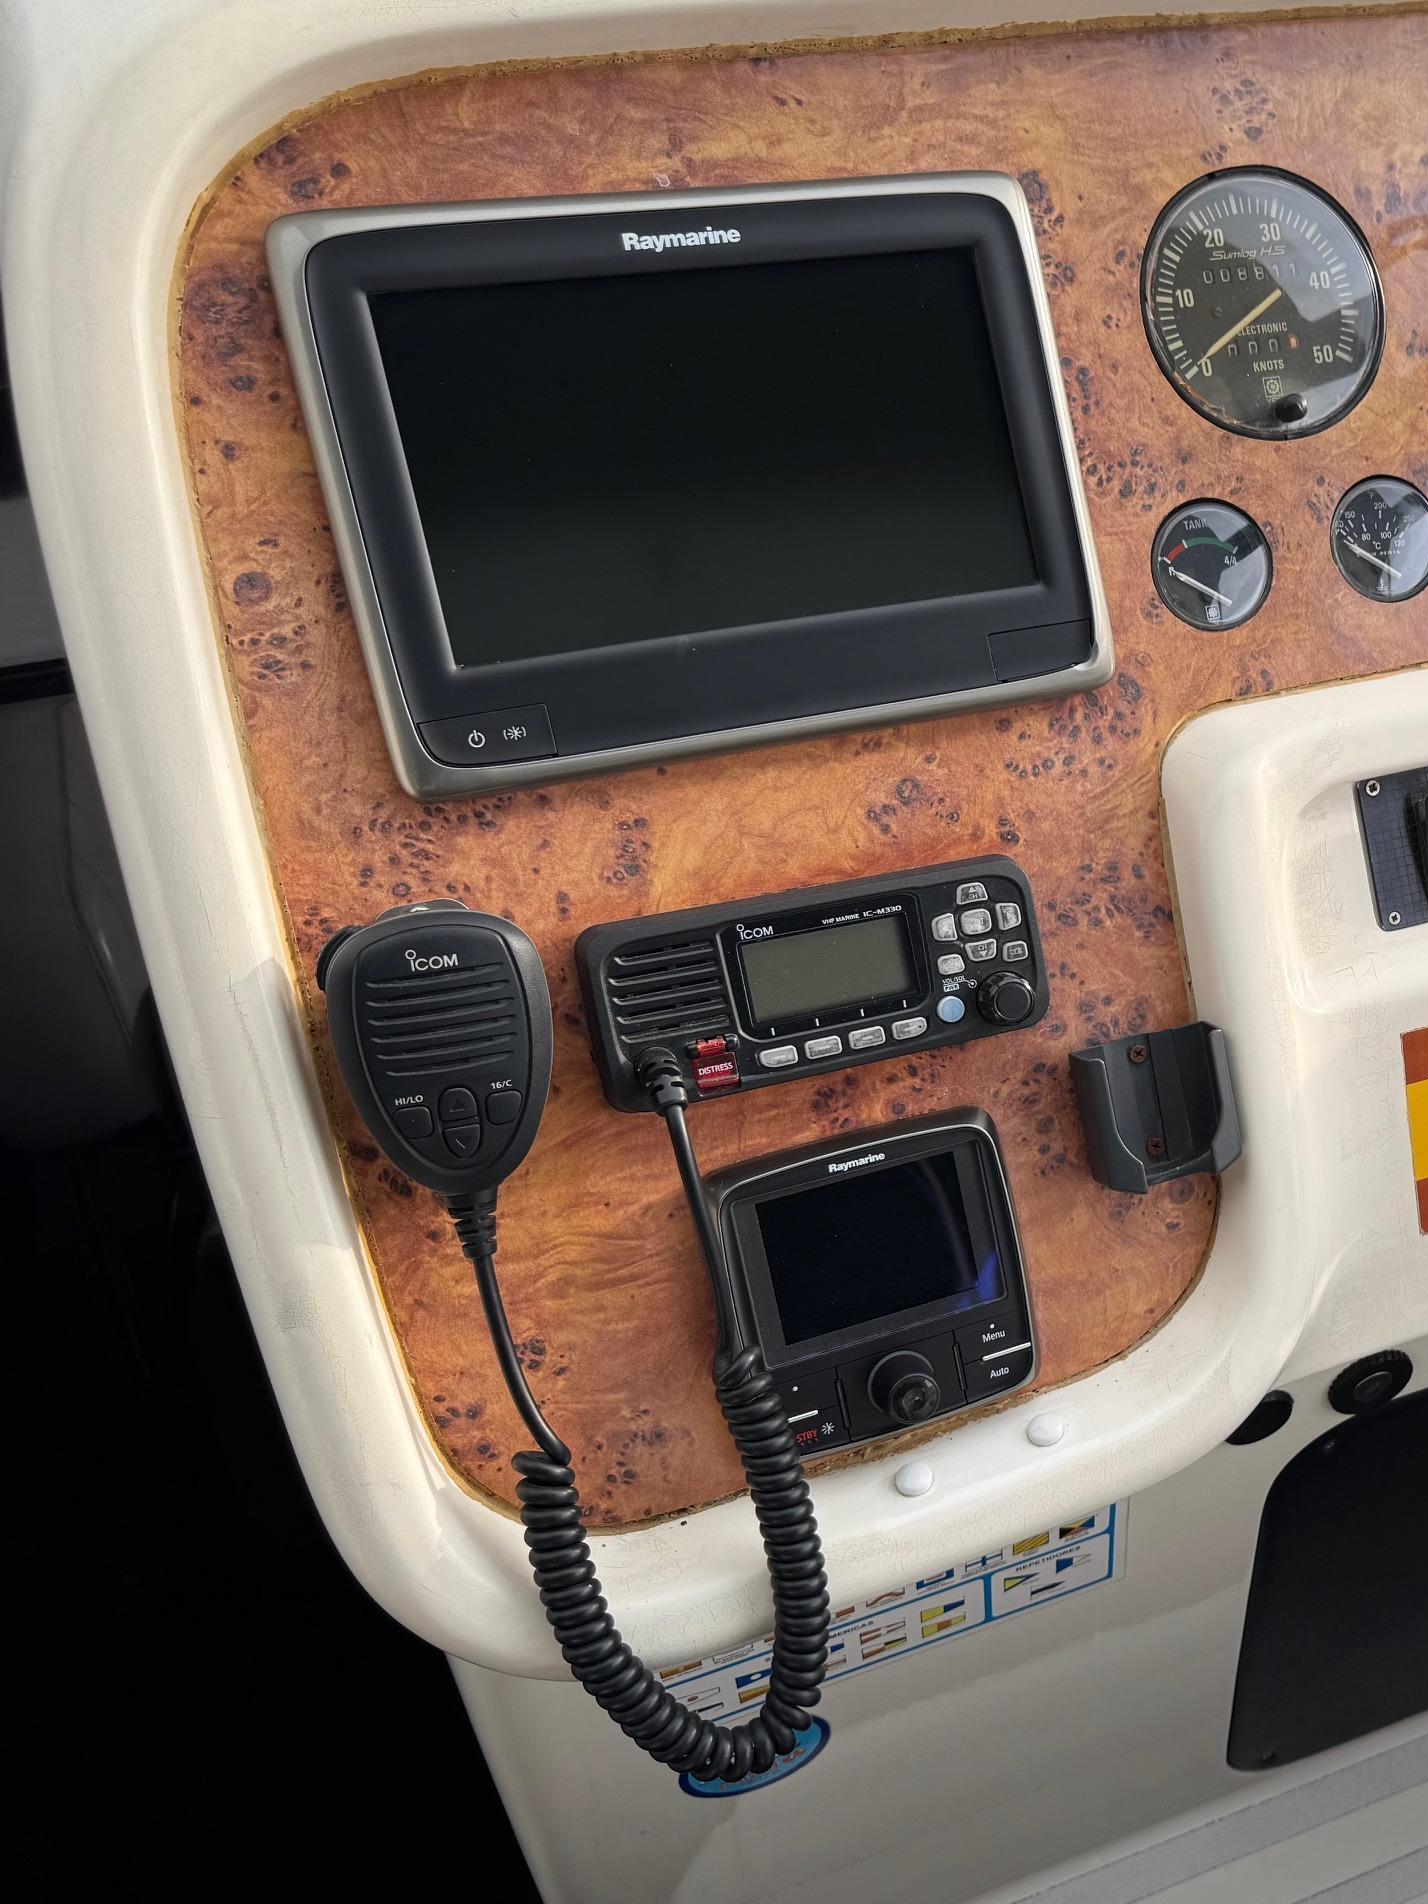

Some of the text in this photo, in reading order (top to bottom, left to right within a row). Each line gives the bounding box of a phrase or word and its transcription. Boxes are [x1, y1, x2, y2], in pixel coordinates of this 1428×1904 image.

[621, 226, 741, 252] Raymarine
[1203, 228, 1224, 248] 20
[1260, 223, 1281, 242] 30
[1309, 271, 1330, 289] 40
[1176, 288, 1195, 308] 10
[1313, 344, 1333, 364] 50
[1252, 359, 1285, 373] KNOTS
[1183, 518, 1209, 531] TANK
[1361, 532, 1371, 541] 80
[1380, 531, 1392, 540] 100
[821, 904, 902, 926] VHF MARINE IC-M330
[698, 1061, 734, 1077] DISTRESS
[490, 1079, 513, 1091] 16/C
[394, 1094, 424, 1107] HI/LO
[828, 1152, 886, 1173] Raymarine
[982, 1330, 1006, 1343] Menu
[990, 1366, 1010, 1379] Auto
[796, 1428, 817, 1443] STBY
[828, 1620, 874, 1640] MERICAS
